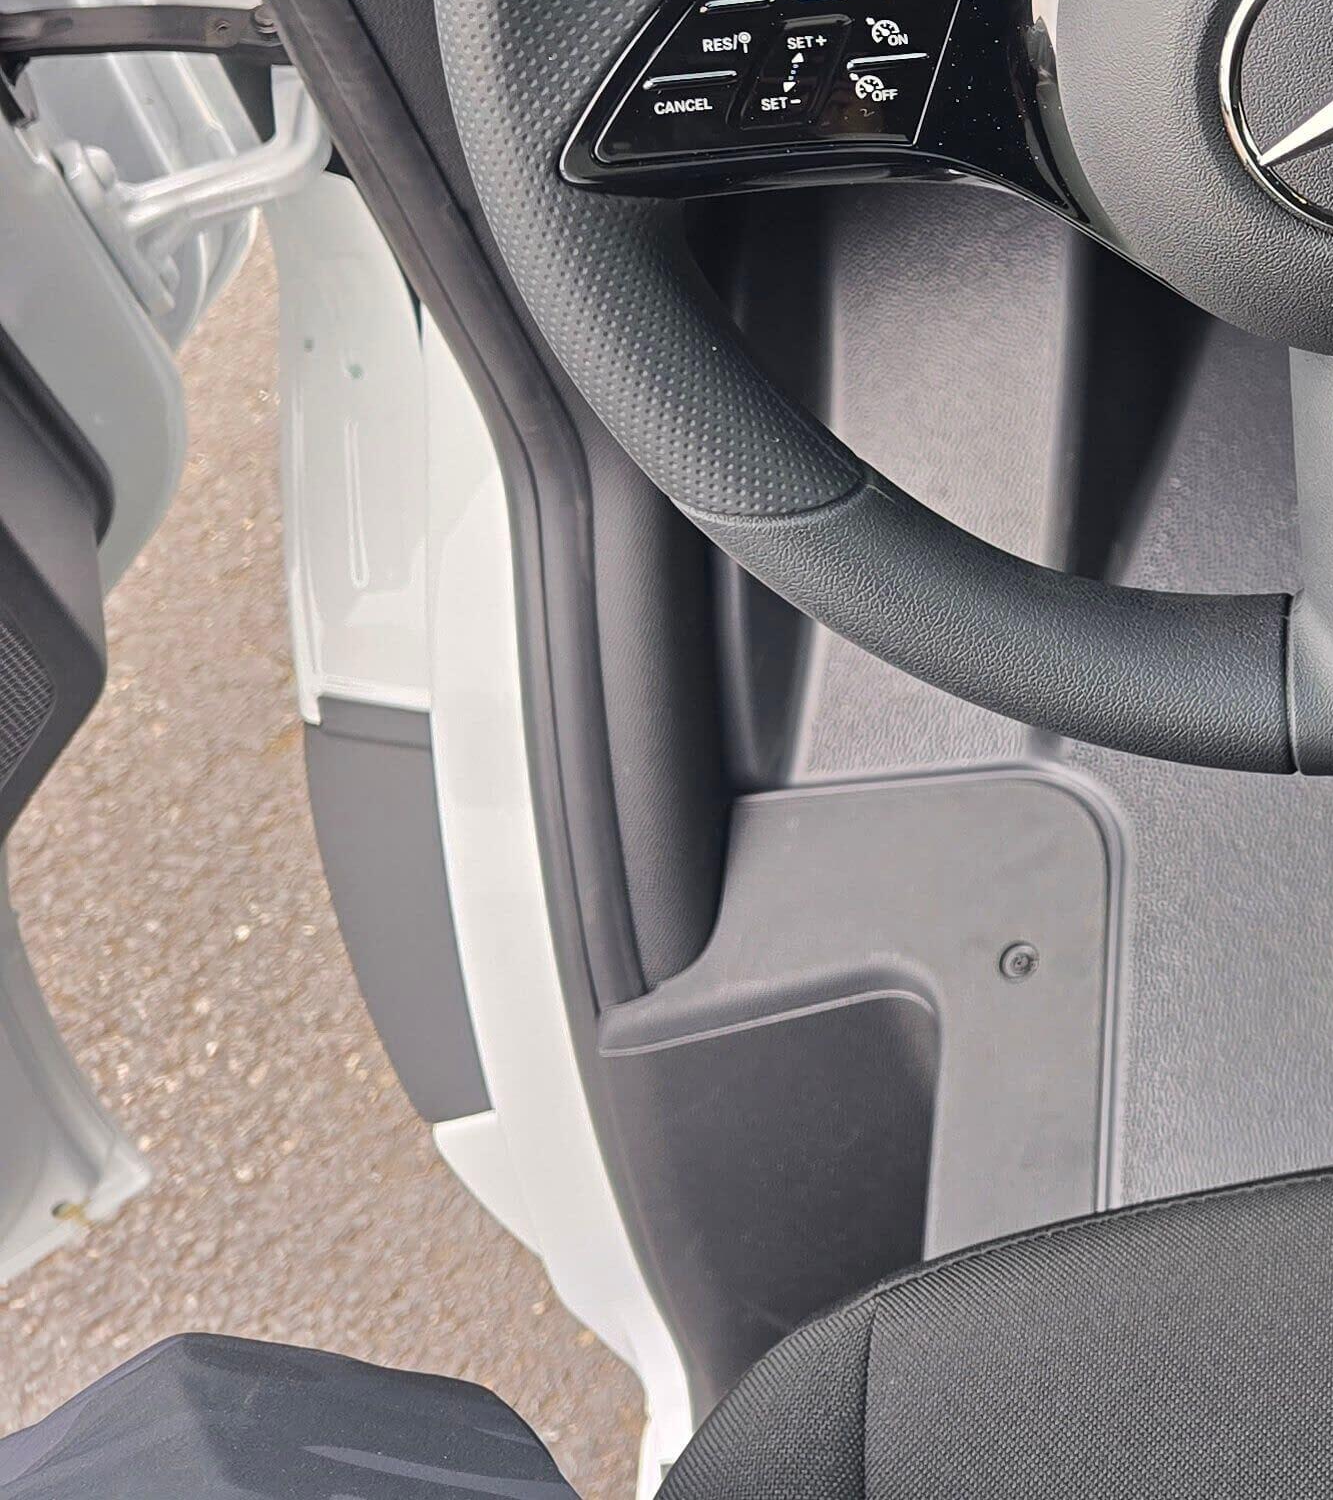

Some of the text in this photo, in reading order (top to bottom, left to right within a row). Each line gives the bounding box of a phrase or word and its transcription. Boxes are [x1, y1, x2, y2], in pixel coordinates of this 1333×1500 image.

[887, 33, 909, 47] ON
[871, 88, 898, 102] OFF
[653, 97, 713, 115] CANCEL
